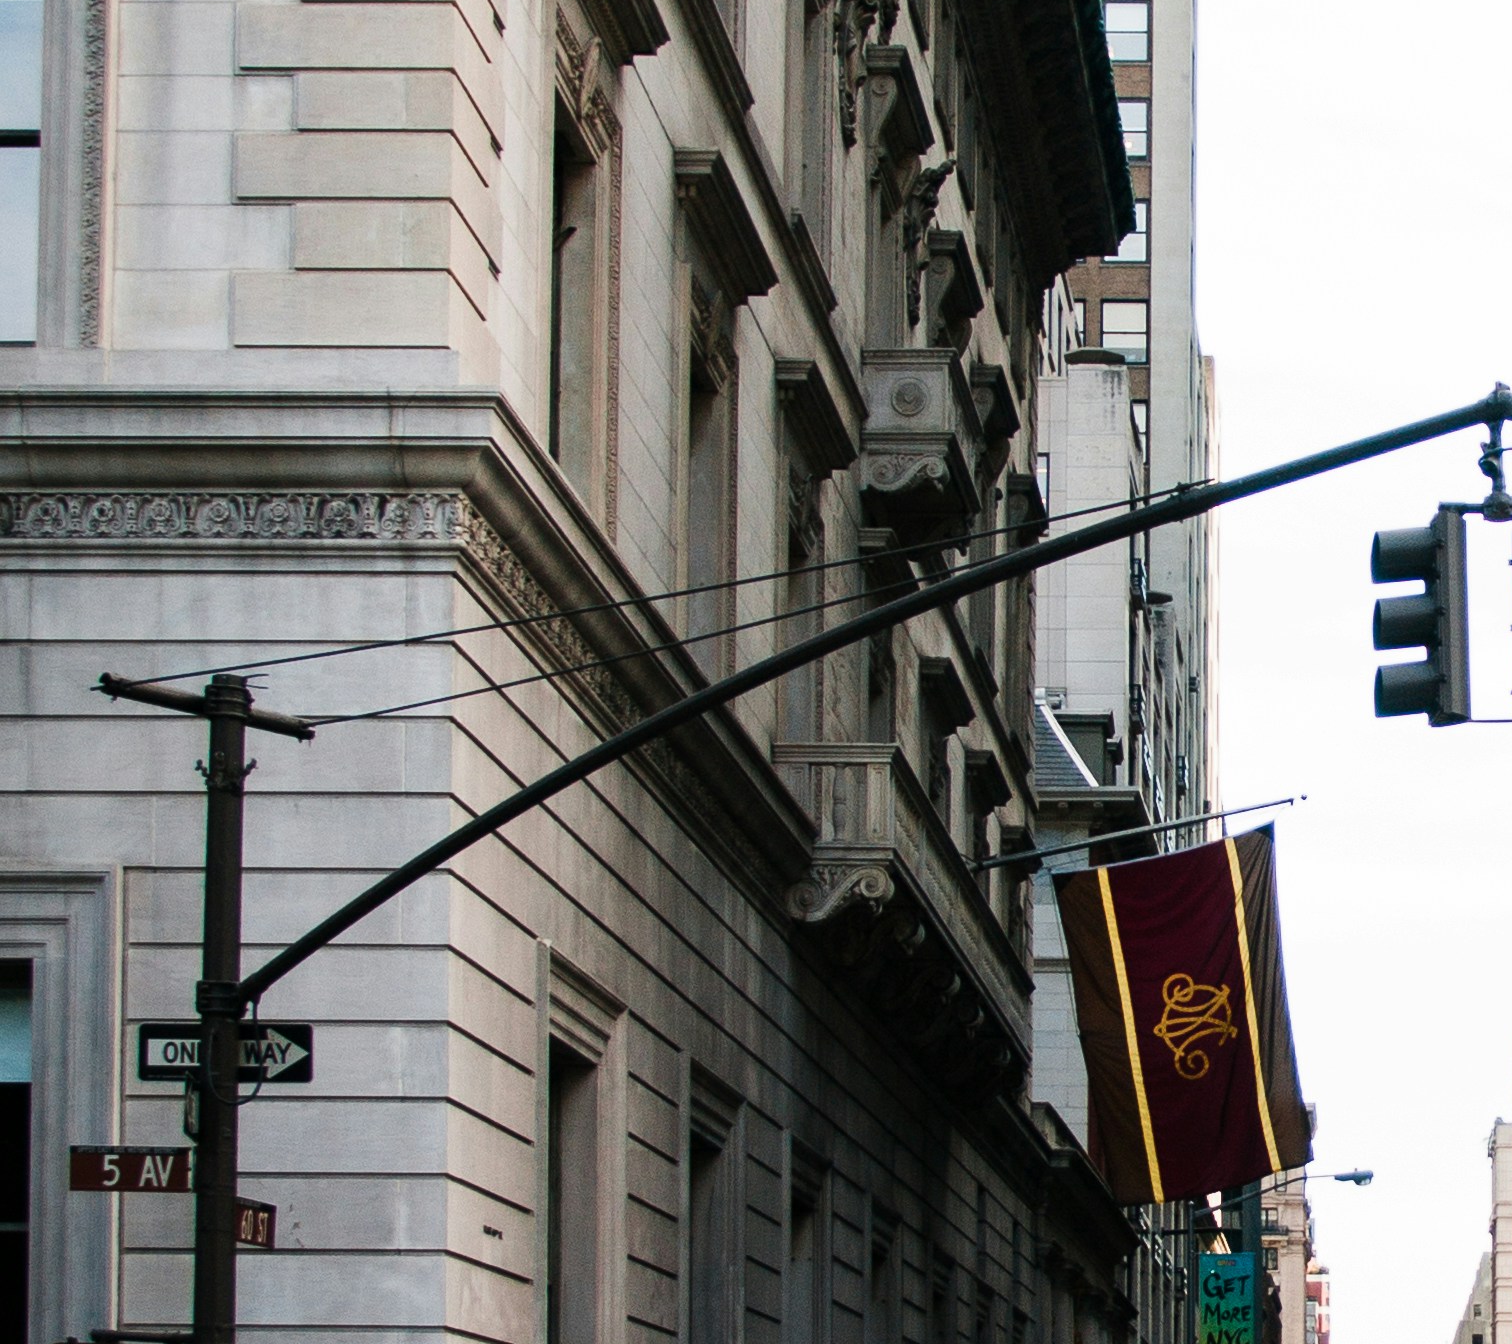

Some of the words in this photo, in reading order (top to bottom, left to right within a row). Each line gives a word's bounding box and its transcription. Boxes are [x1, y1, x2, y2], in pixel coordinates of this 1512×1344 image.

[163, 1041, 201, 1064] ON
[243, 1042, 292, 1065] WAY
[102, 1154, 120, 1187] 5
[139, 1155, 174, 1188] AV
[241, 1208, 254, 1241] 60
[257, 1212, 269, 1244] ST
[1203, 1271, 1250, 1301] GET
[1203, 1304, 1250, 1326] MORE
